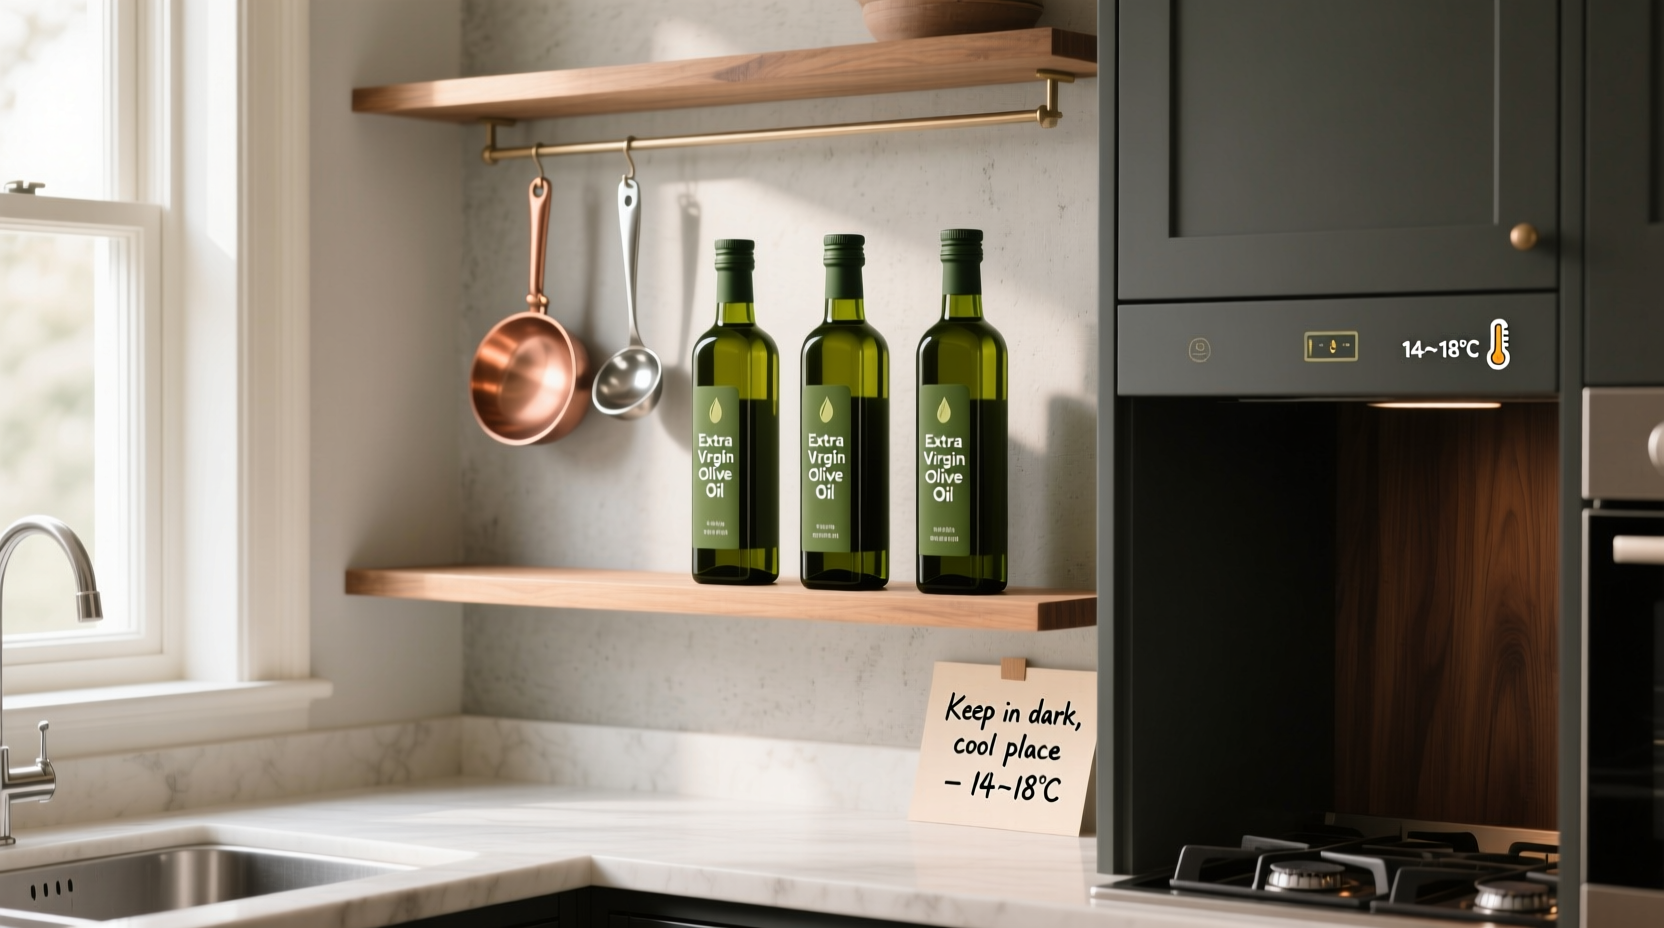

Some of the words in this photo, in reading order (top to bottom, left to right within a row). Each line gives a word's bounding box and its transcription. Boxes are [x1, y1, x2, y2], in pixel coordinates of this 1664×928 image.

[1402, 339, 1480, 359] 14~18°C
[698, 433, 732, 447] Extra
[808, 433, 844, 448] Extra
[925, 433, 962, 448] Extra
[923, 451, 965, 469] Virgin
[698, 467, 733, 481] Olive
[808, 467, 844, 482] Olive
[925, 468, 963, 484] Olive
[706, 483, 724, 498] Oil
[815, 484, 834, 500] Oil
[933, 486, 953, 502] Oil
[945, 692, 995, 731] Keep
[1003, 701, 1020, 723] in
[1029, 698, 1081, 732] dark,
[954, 733, 997, 756] cool
[1002, 733, 1061, 768] place
[971, 771, 1062, 803] 14~18°C
